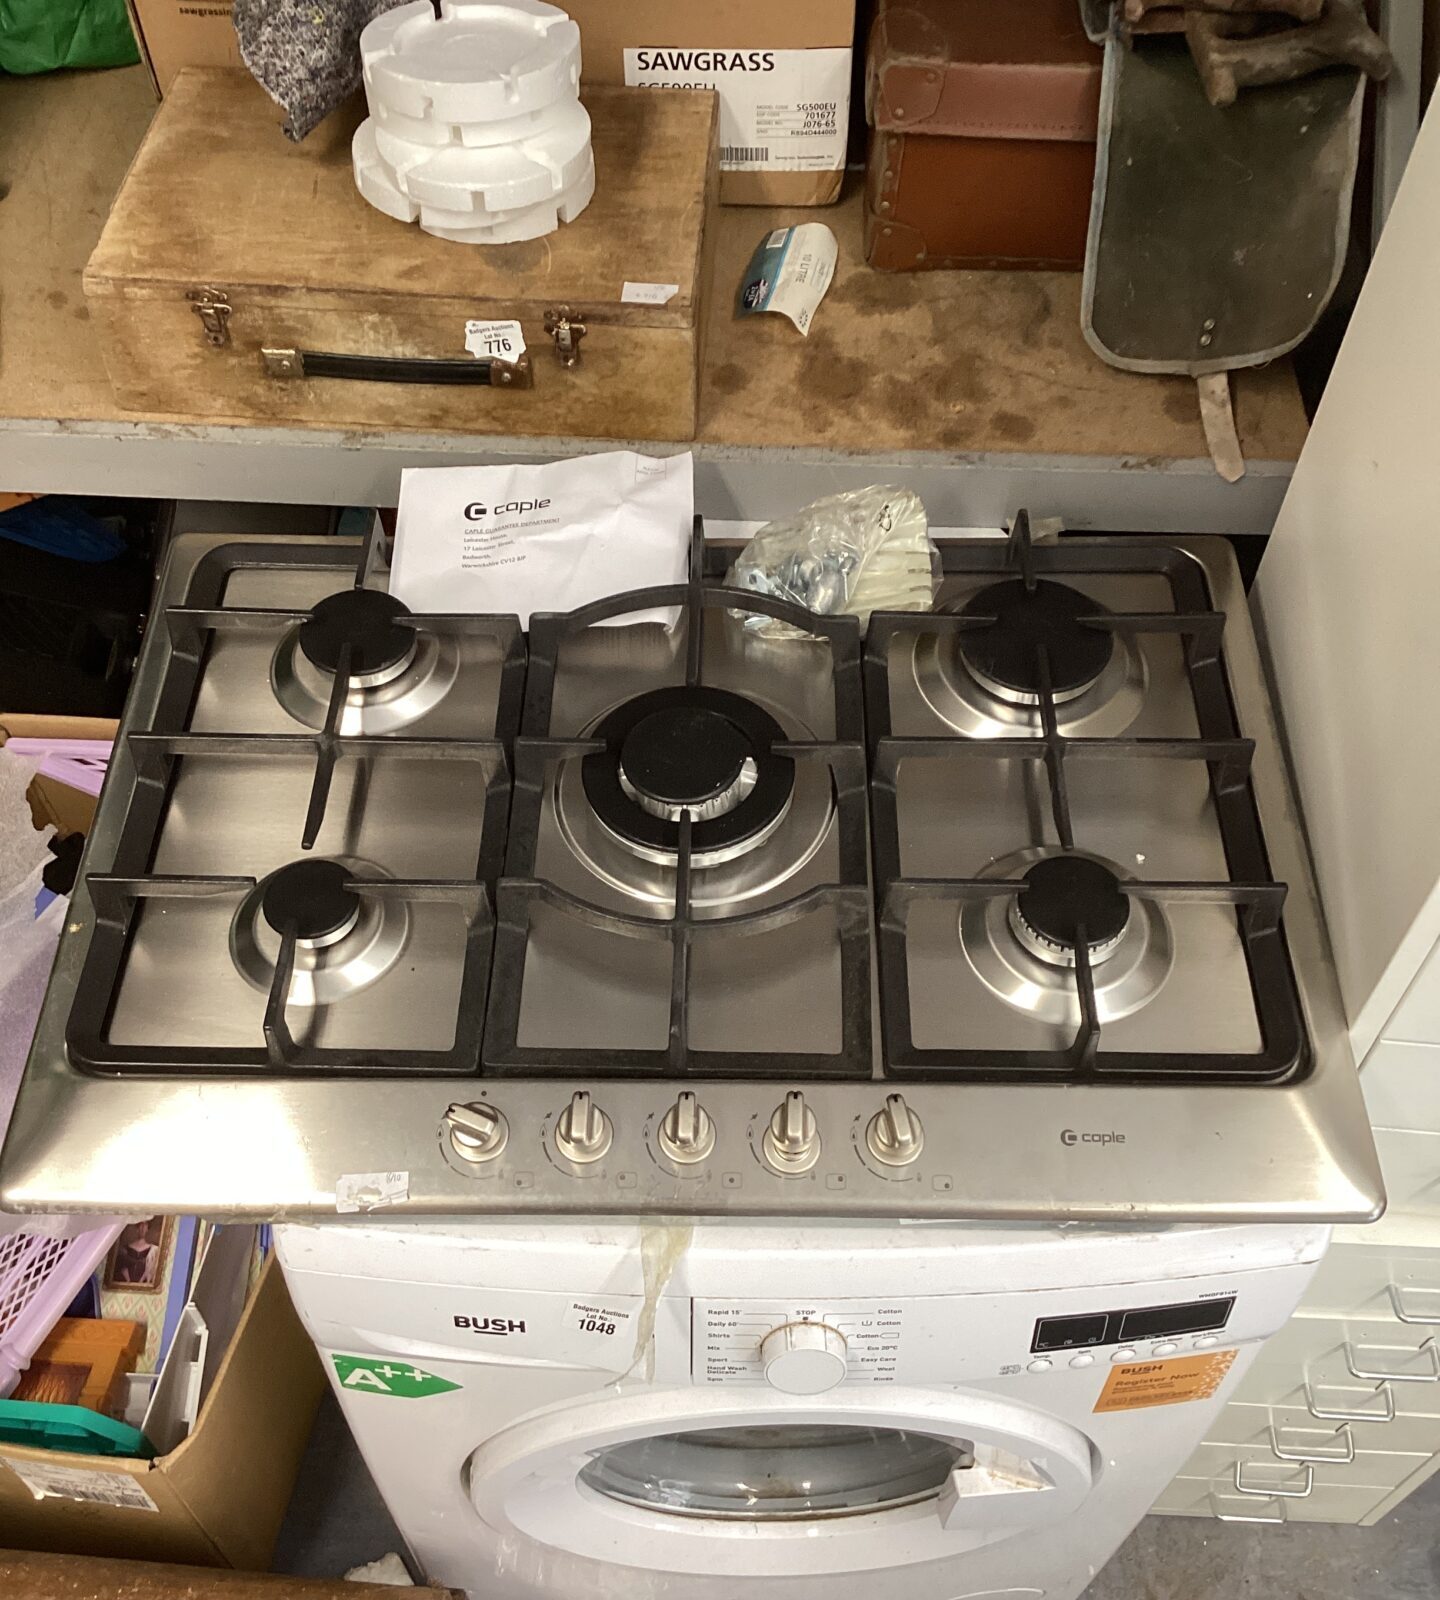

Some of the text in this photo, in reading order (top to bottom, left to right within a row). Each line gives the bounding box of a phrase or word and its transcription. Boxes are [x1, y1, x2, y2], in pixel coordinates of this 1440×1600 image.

[637, 51, 775, 72] SAWGRASS
[796, 102, 837, 112] SG500EU
[805, 111, 836, 119] 701677
[803, 120, 836, 128] J076-65
[795, 262, 812, 284] LITRE
[469, 327, 490, 335] Badgers
[484, 338, 512, 354] 776
[494, 498, 551, 515] caple
[520, 517, 560, 528] DEPARTMENT
[500, 556, 515, 565] CV12
[1081, 1130, 1126, 1147] caple
[573, 1303, 630, 1319] Badgers Auctions
[453, 1315, 526, 1335] BUSH
[578, 1318, 616, 1336] 1048
[343, 1364, 432, 1391] A++
[1120, 1364, 1163, 1375] BUSH
[1115, 1372, 1200, 1387] Register Now
